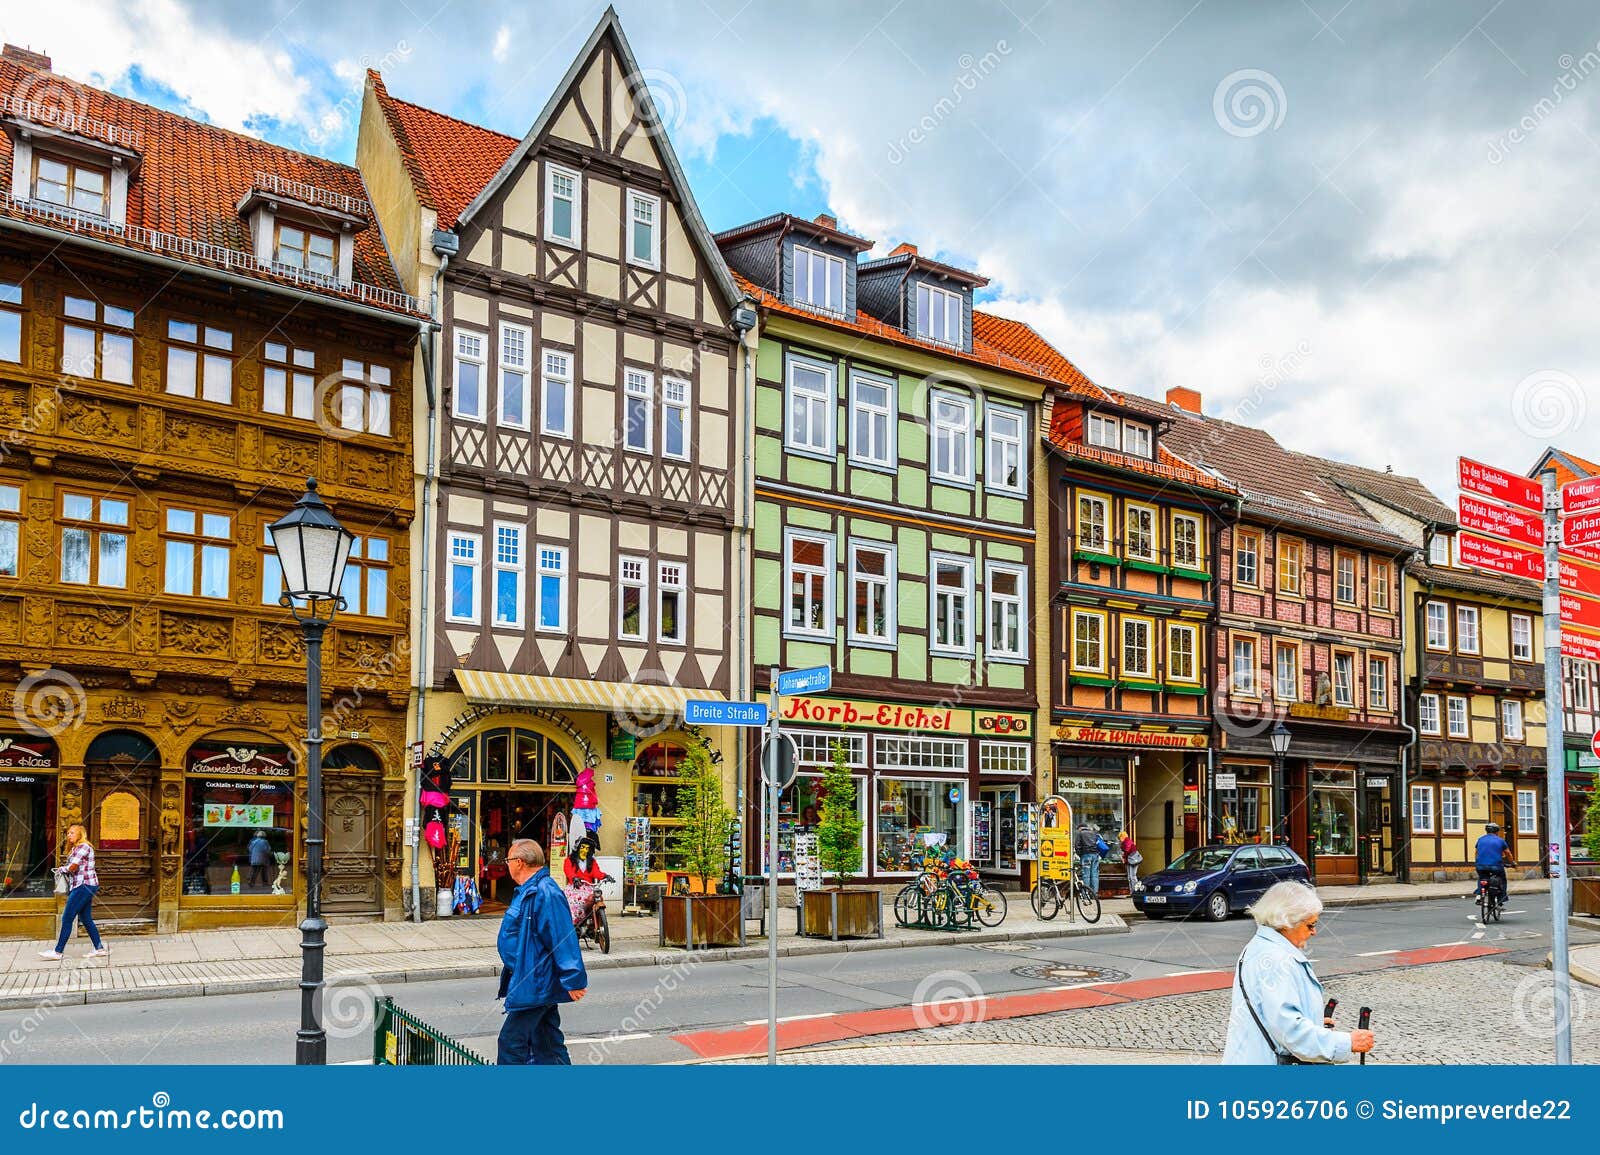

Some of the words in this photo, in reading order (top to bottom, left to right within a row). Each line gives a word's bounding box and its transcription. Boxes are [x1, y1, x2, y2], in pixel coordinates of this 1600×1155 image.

[693, 704, 722, 719] Breite
[727, 706, 760, 720] Straße
[783, 698, 952, 730] Korb-Eichel
[1109, 729, 1188, 747] Winkelmann
